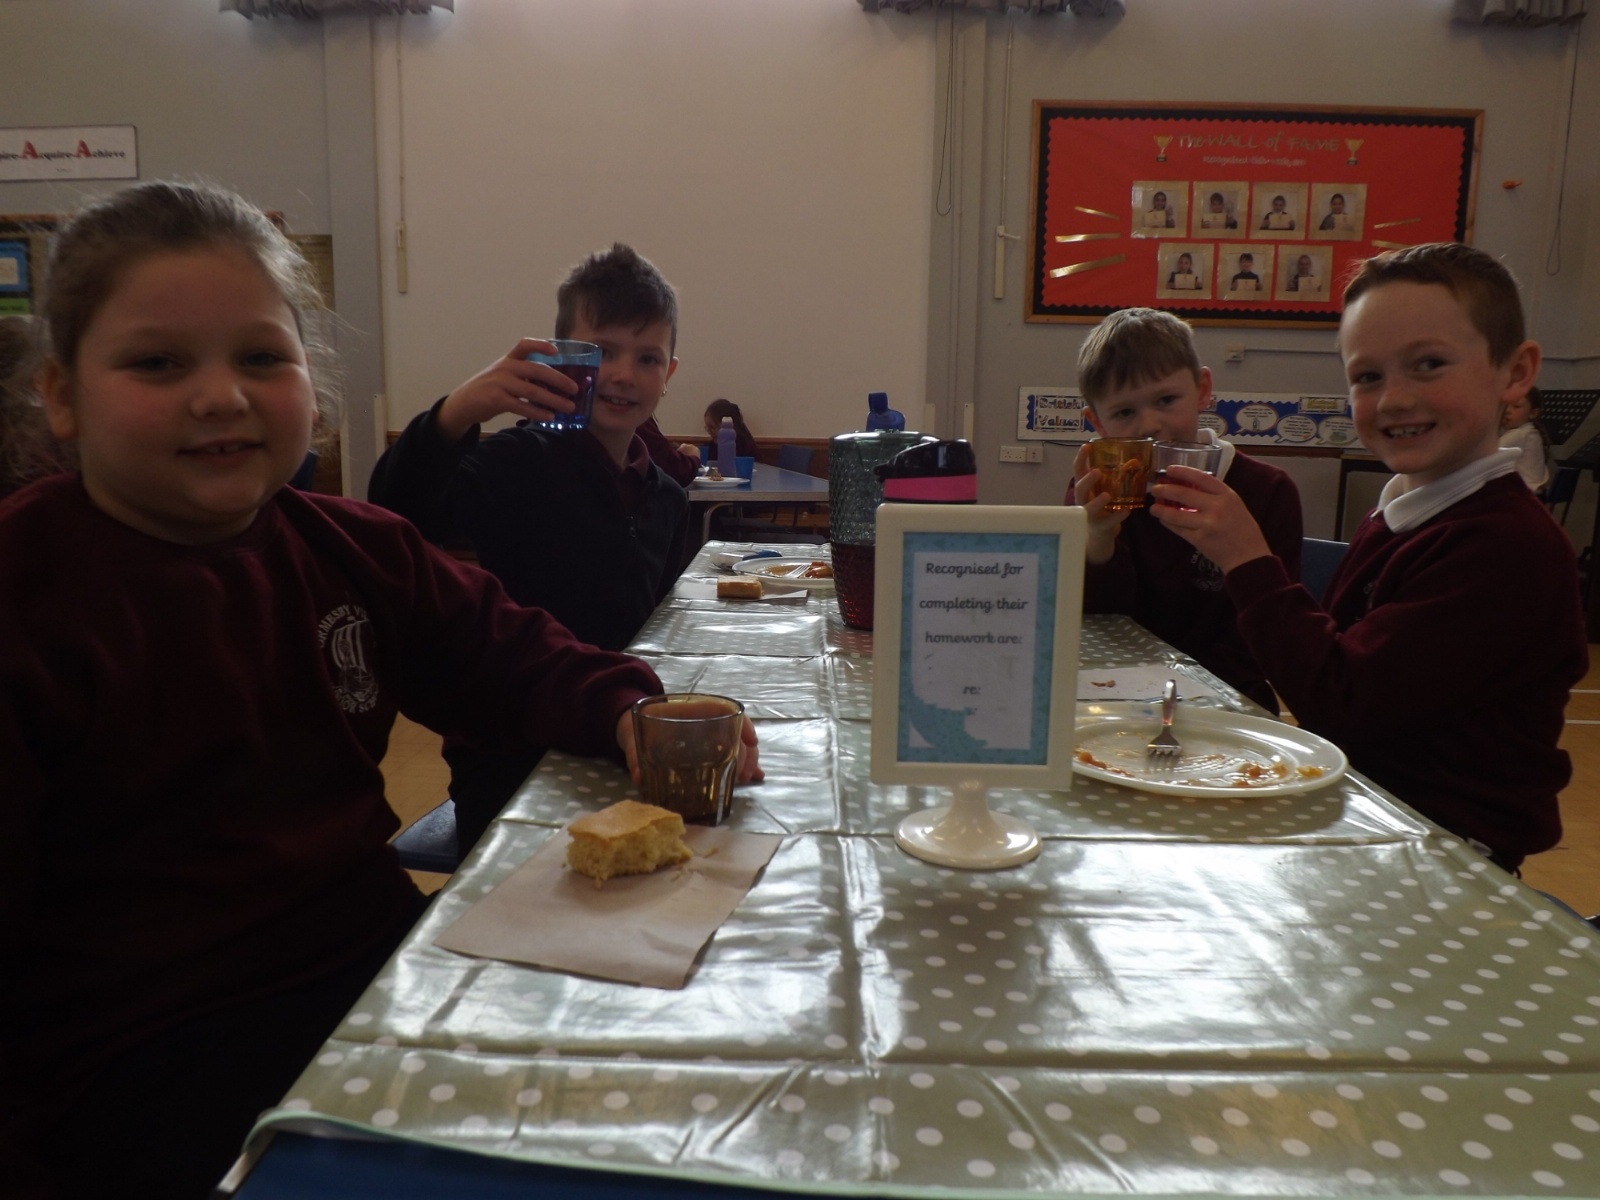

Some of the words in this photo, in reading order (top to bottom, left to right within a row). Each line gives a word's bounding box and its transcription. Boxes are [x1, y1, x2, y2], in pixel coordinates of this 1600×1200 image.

[1265, 130, 1285, 153] of
[1287, 136, 1340, 153] FAME
[925, 562, 999, 578] Recognised
[1000, 562, 1024, 579] for
[919, 597, 993, 613] completing
[996, 598, 1029, 610] their
[924, 631, 995, 644] homework
[996, 634, 1024, 645] are:
